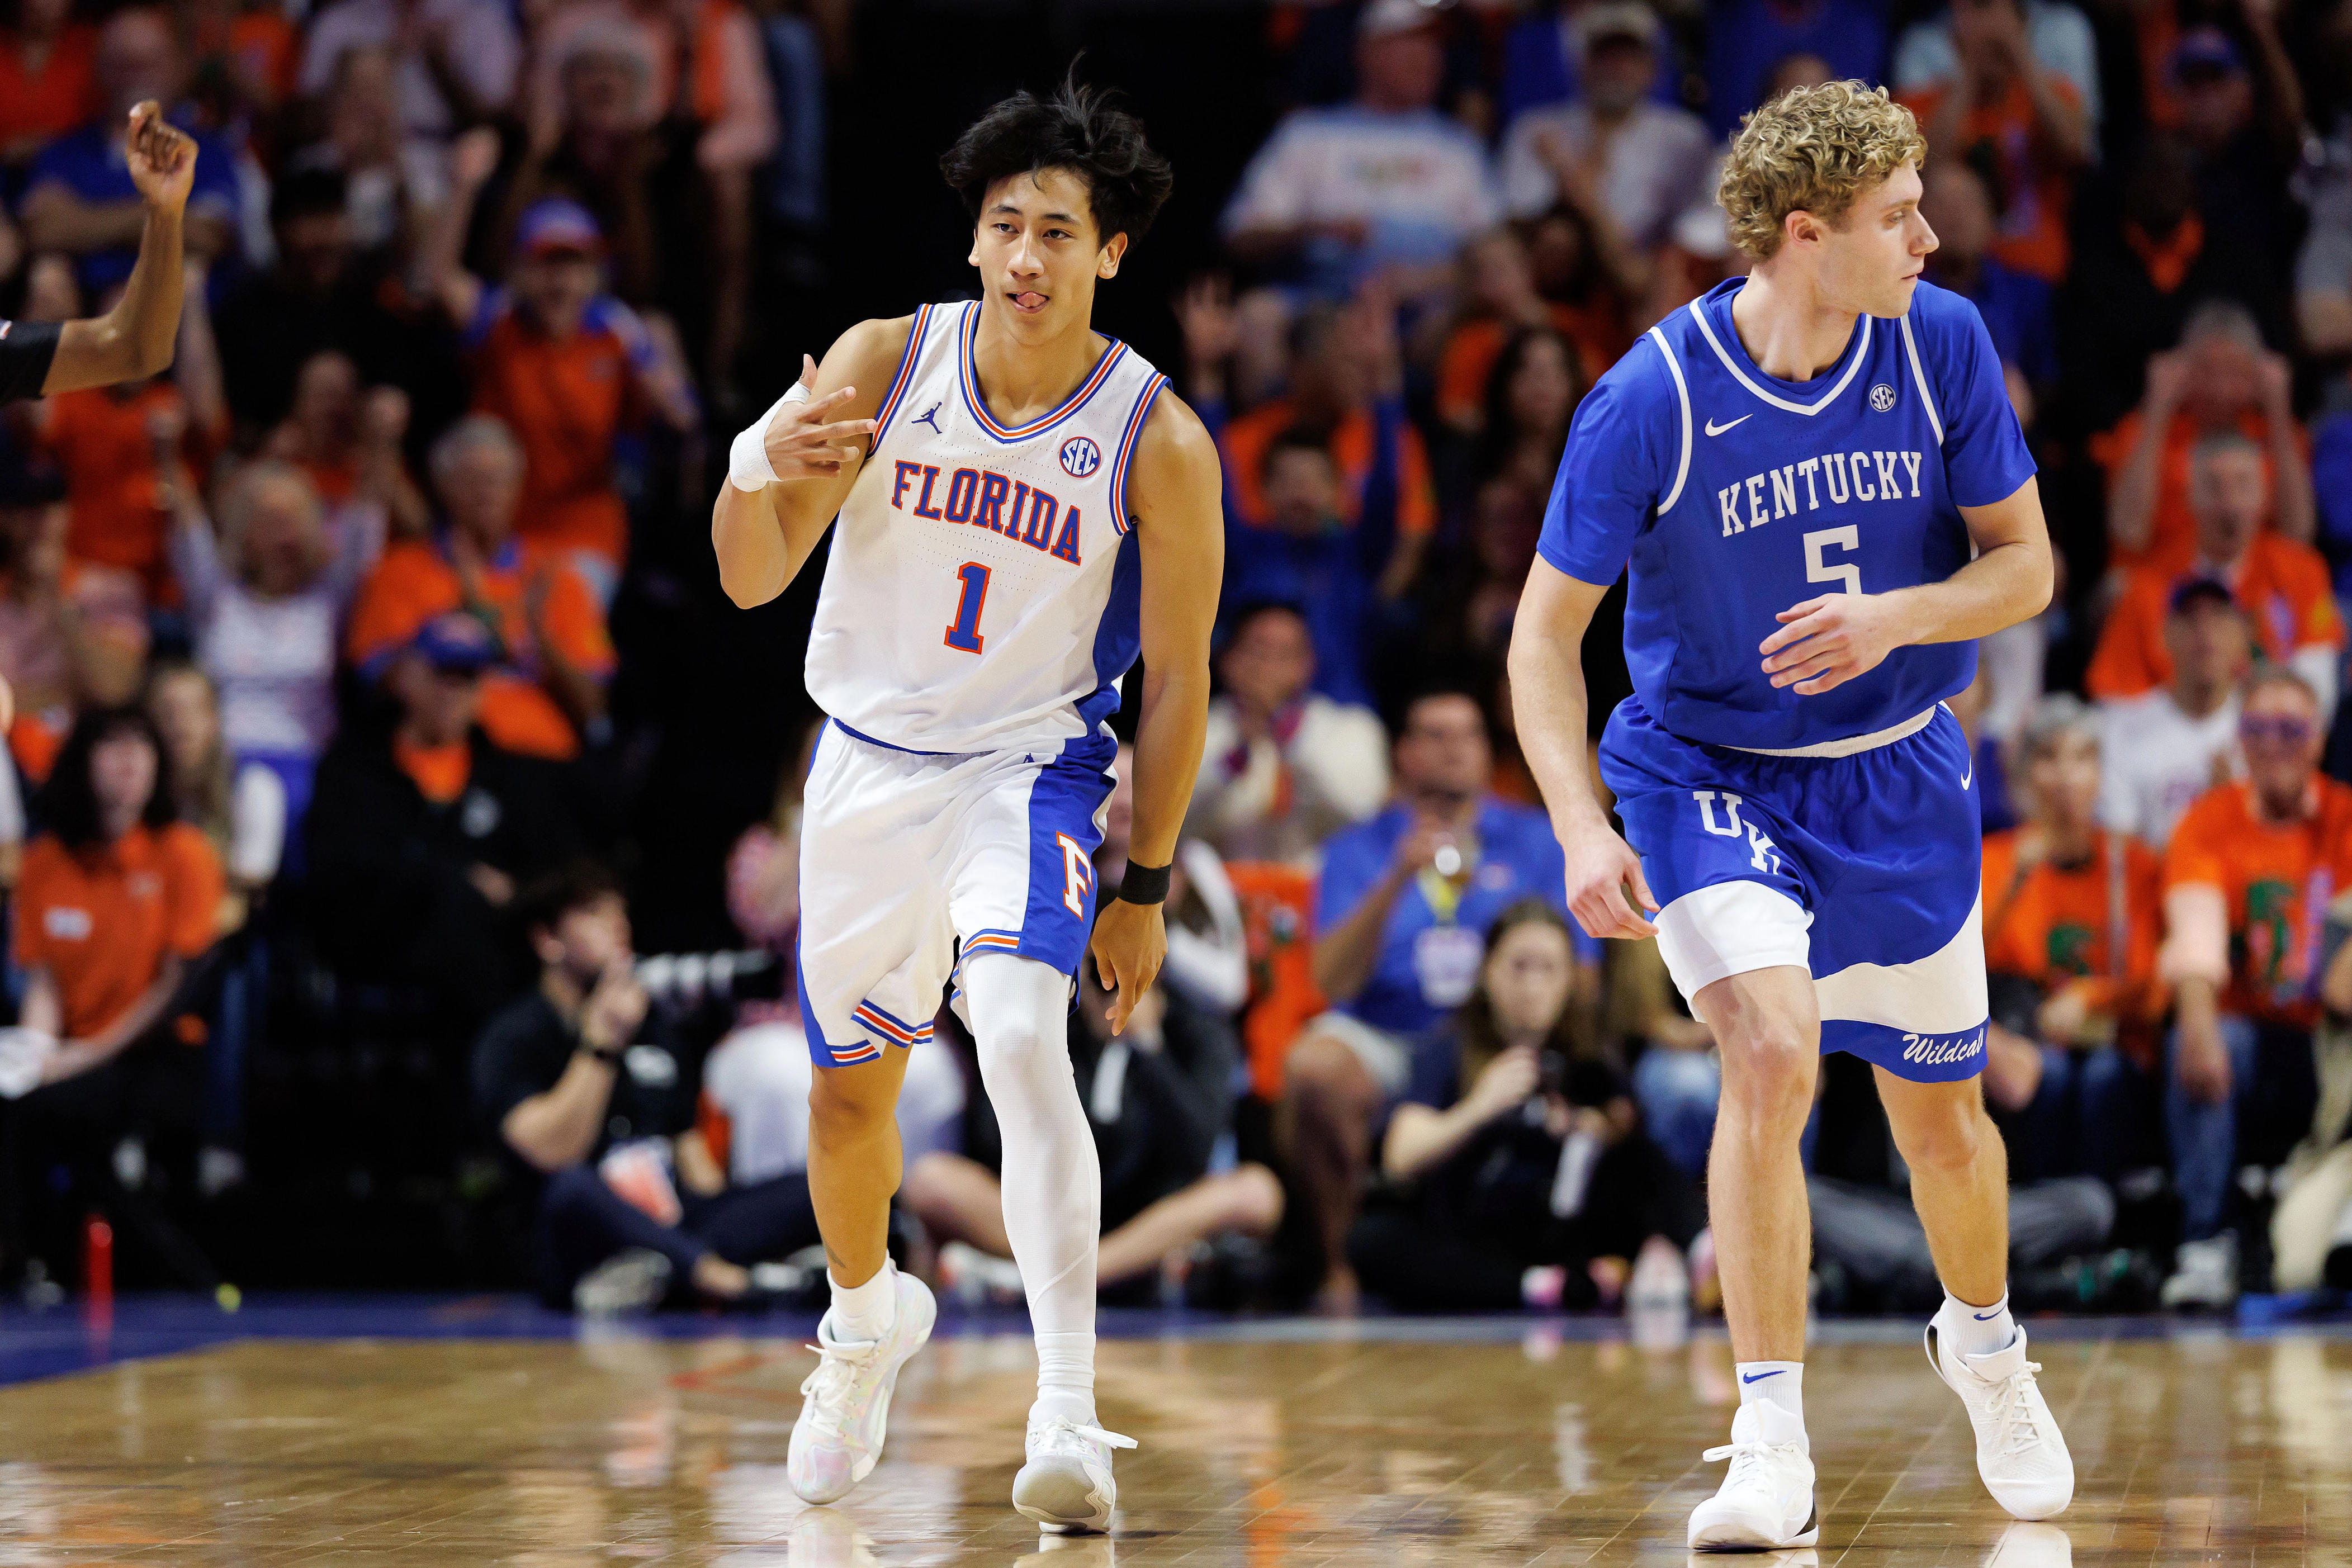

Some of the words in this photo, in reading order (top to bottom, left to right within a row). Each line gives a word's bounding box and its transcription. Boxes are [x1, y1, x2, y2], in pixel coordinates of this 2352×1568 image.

[1872, 386, 1894, 410] SEC
[1062, 439, 1098, 475] SEC
[1718, 451, 1922, 537] KENTUCKY
[892, 459, 1081, 566] FLORIDA
[1803, 524, 1862, 594] 5
[944, 561, 992, 655] 1
[1056, 831, 1093, 922] F
